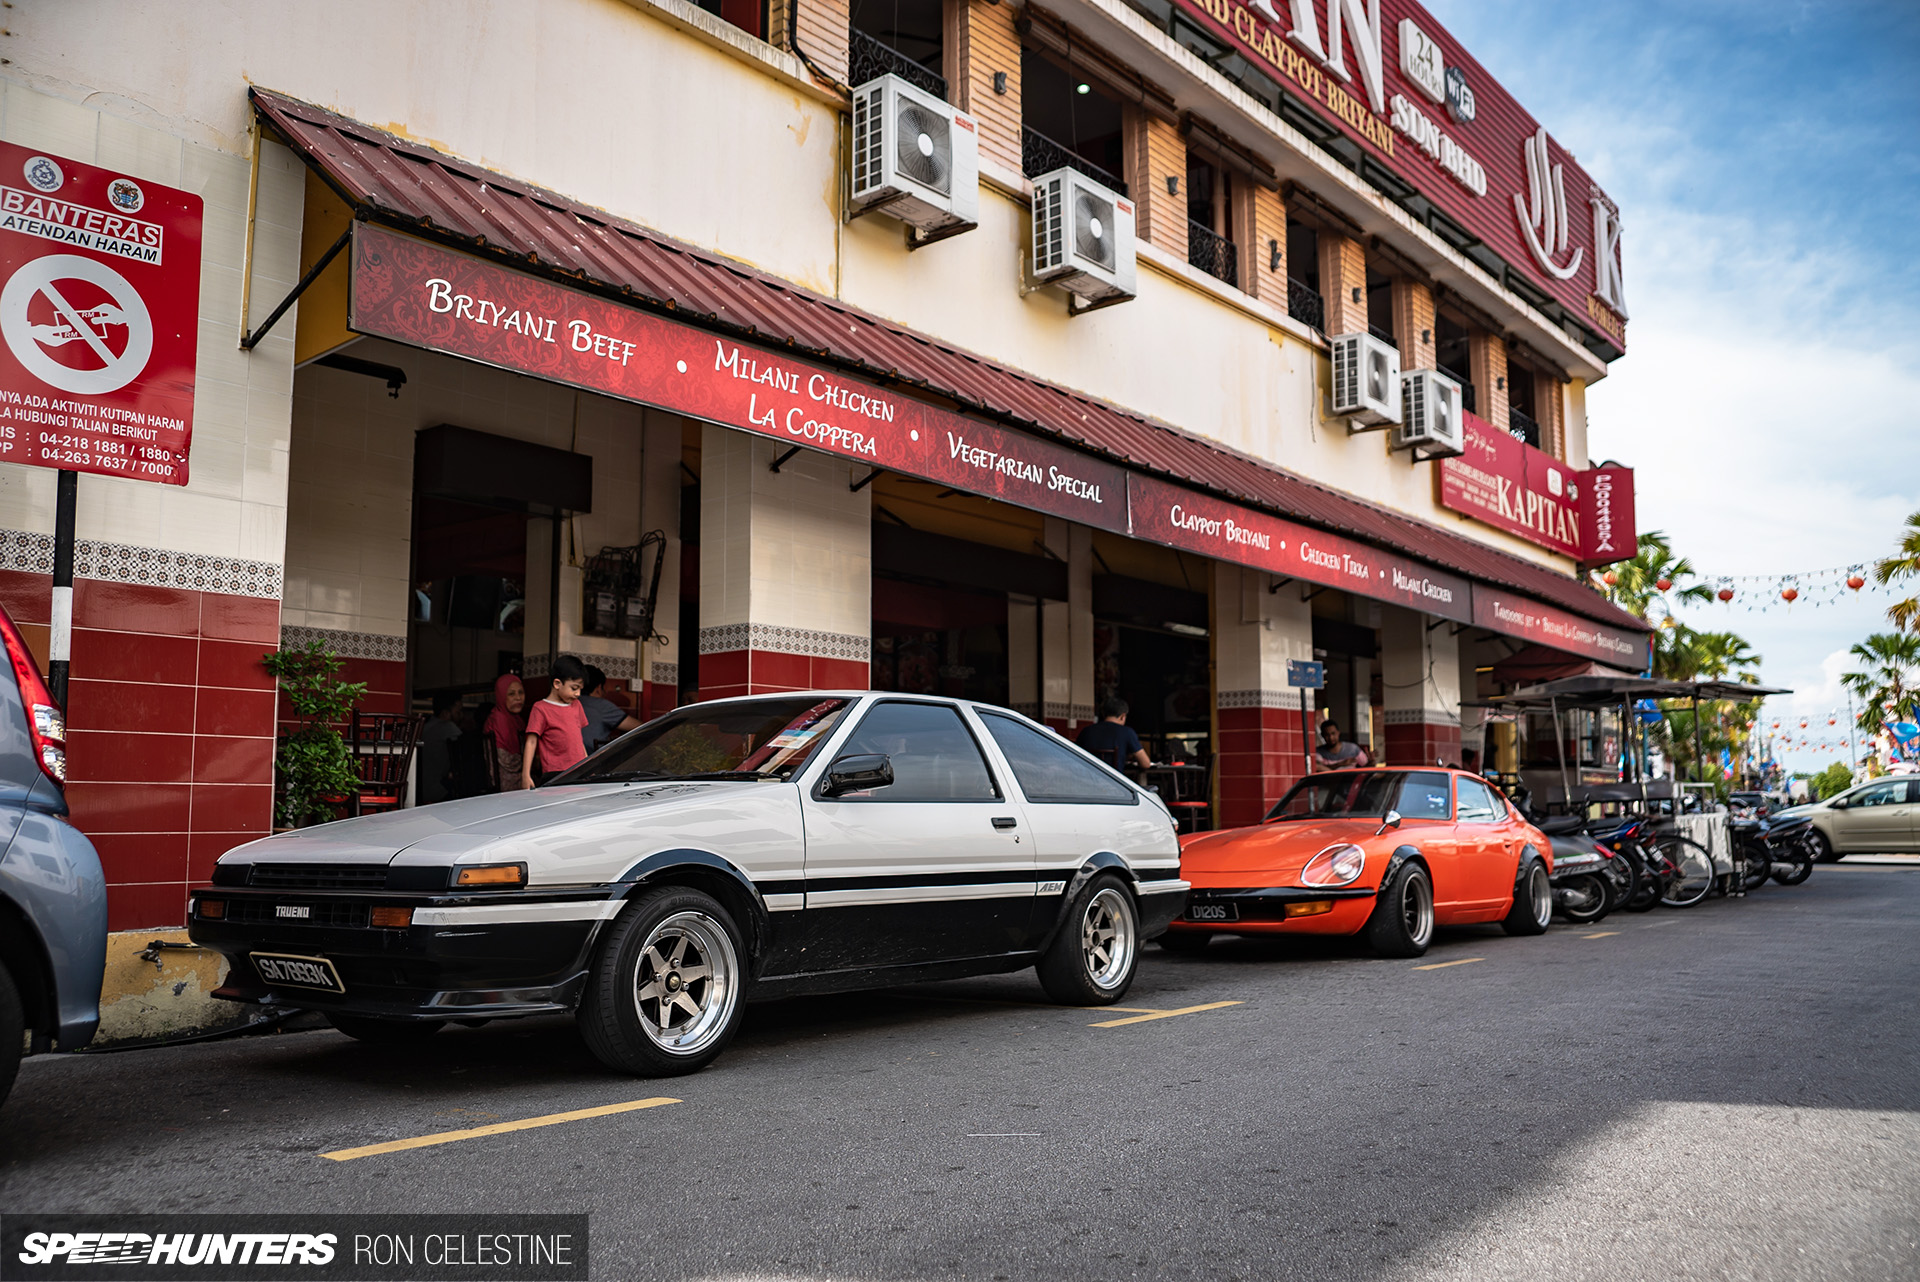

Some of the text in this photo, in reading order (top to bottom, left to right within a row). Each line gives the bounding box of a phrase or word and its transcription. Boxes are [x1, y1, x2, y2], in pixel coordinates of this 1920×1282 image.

[1416, 32, 1434, 72] 24
[1234, 6, 1322, 100] CLAYPOT
[1327, 78, 1395, 158] BRIYANI
[1410, 54, 1444, 100] HOURS
[1390, 94, 1487, 197] SDN BHD
[3, 191, 160, 246] BANTERAS
[3, 215, 157, 262] ATENDAN HARAM
[425, 278, 637, 367] BRIYANI BEEF
[715, 340, 894, 423] MILANI CHICKEN
[15, 408, 68, 427] HUBUNGI
[71, 417, 109, 434] TALIAN
[112, 423, 158, 441] BERIKUT
[24, 394, 49, 409] ADA
[51, 399, 97, 417] AKTIVITI
[100, 406, 145, 425] KUTIPAN
[147, 414, 184, 431] HARAM
[748, 394, 877, 456] LA COPPERA
[39, 432, 89, 450] 04-218
[94, 440, 125, 455] 1881
[139, 447, 170, 462] 1880
[41, 447, 90, 465] 04-263
[95, 455, 128, 470] 7637
[140, 461, 172, 476] 7000
[947, 431, 1103, 503] VEGETARIAN SPECIAL
[1170, 505, 1270, 551] CLAYPOT BRIYANI
[1497, 474, 1580, 548] KAPITAN
[1300, 542, 1341, 570] CHICKEN
[1039, 883, 1063, 893] AEM
[275, 905, 310, 918] TRUENO
[259, 959, 333, 986] SA7893K
